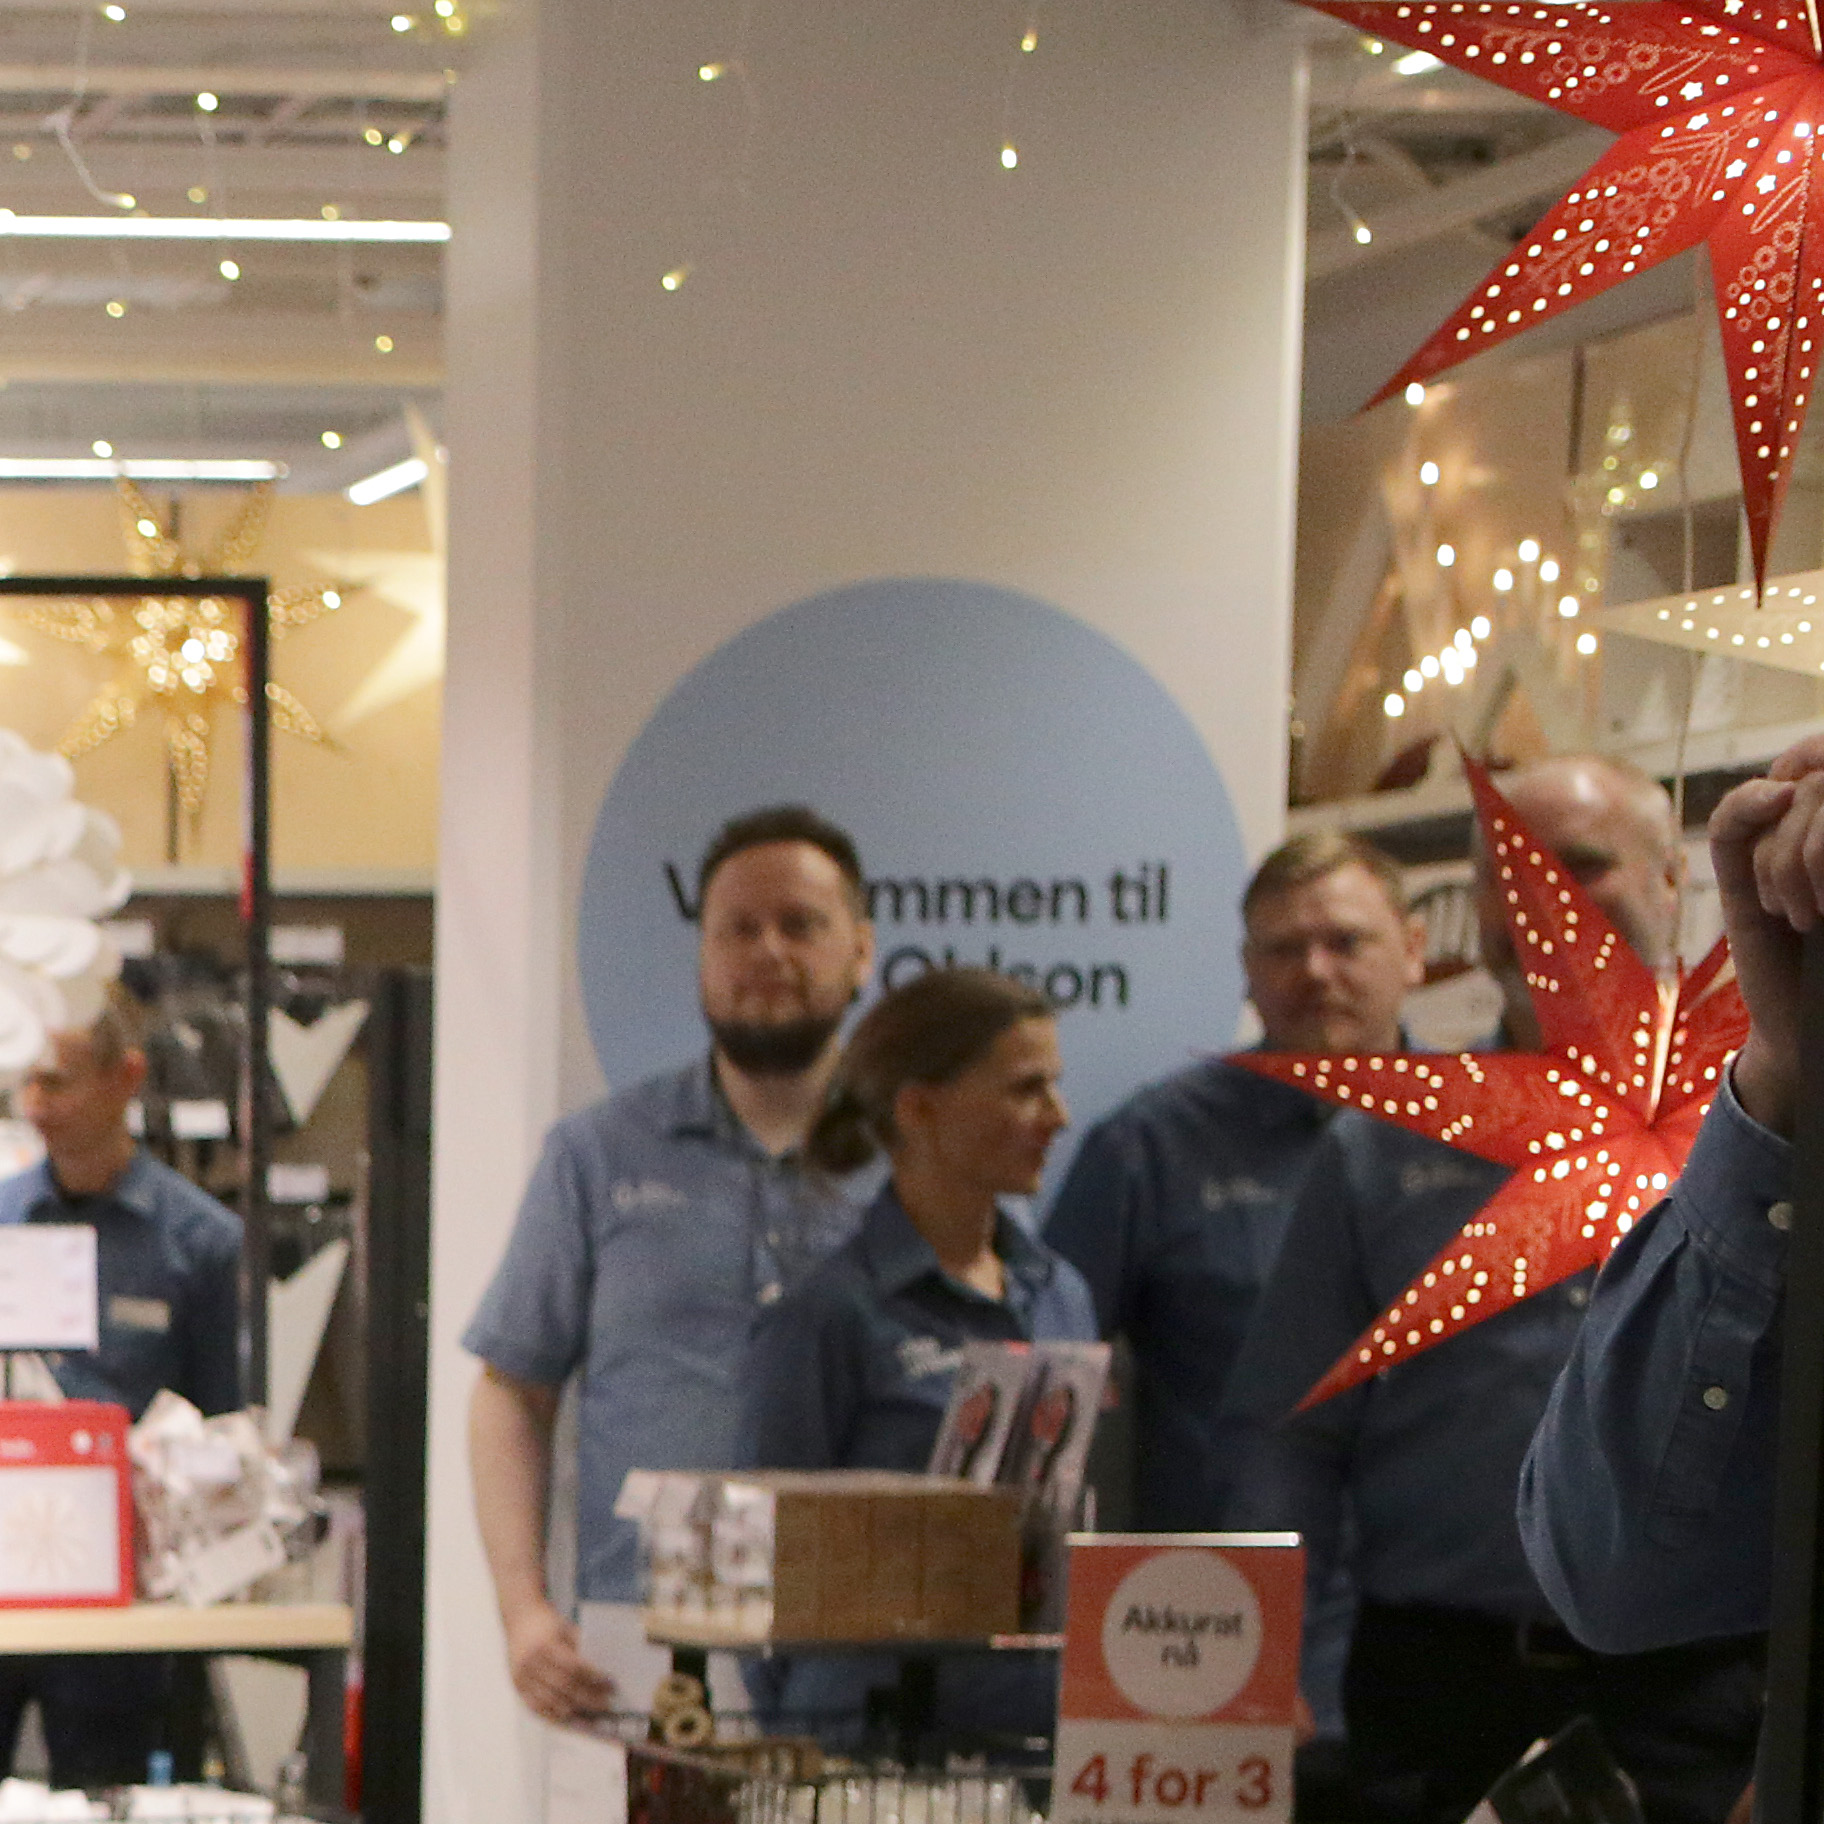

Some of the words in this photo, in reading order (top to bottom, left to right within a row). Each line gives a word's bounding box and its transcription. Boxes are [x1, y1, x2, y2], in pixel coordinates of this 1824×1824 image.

[1109, 862, 1170, 924] til
[1121, 1604, 1243, 1637] Akkurat
[1160, 1640, 1200, 1668] nå
[1070, 1753, 1109, 1805] 4
[1130, 1752, 1220, 1808] for
[1235, 1755, 1273, 1810] 3
